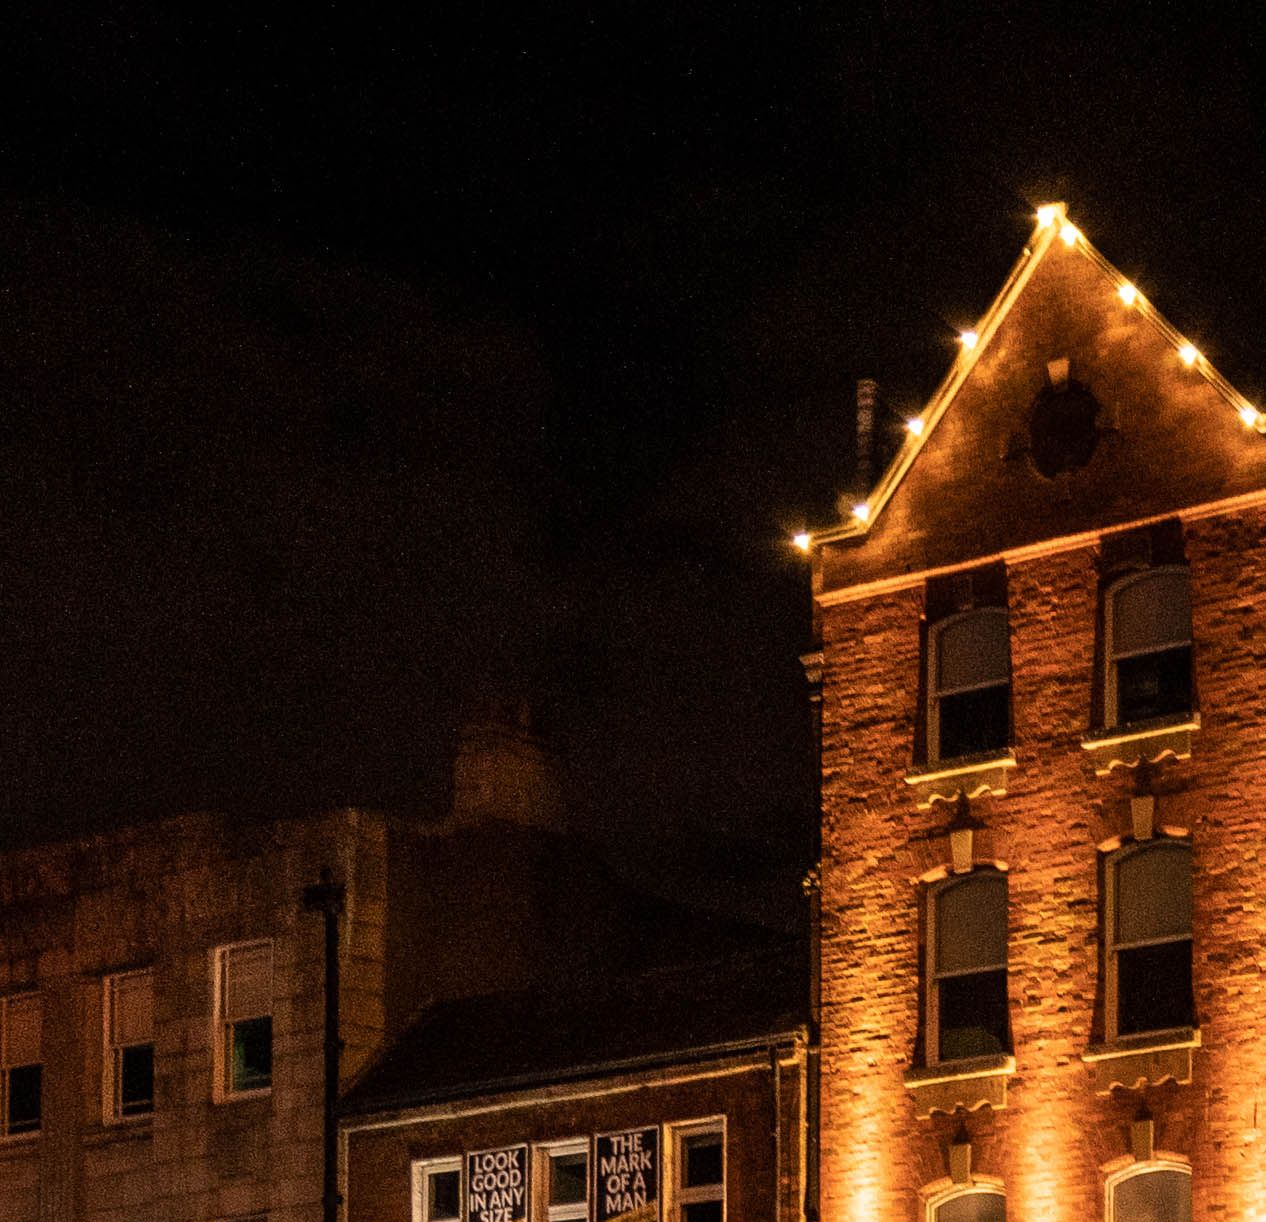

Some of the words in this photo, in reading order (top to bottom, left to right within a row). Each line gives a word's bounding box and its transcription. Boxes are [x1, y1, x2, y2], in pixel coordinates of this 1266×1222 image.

[611, 1134, 643, 1154] THE
[474, 1151, 519, 1174] LOOK
[601, 1152, 652, 1177] MARK
[472, 1170, 521, 1192] GOOD
[607, 1174, 630, 1194] OF
[633, 1172, 646, 1190] A
[470, 1194, 486, 1213] IN
[490, 1188, 524, 1209] ANY
[606, 1191, 647, 1214] MAN
